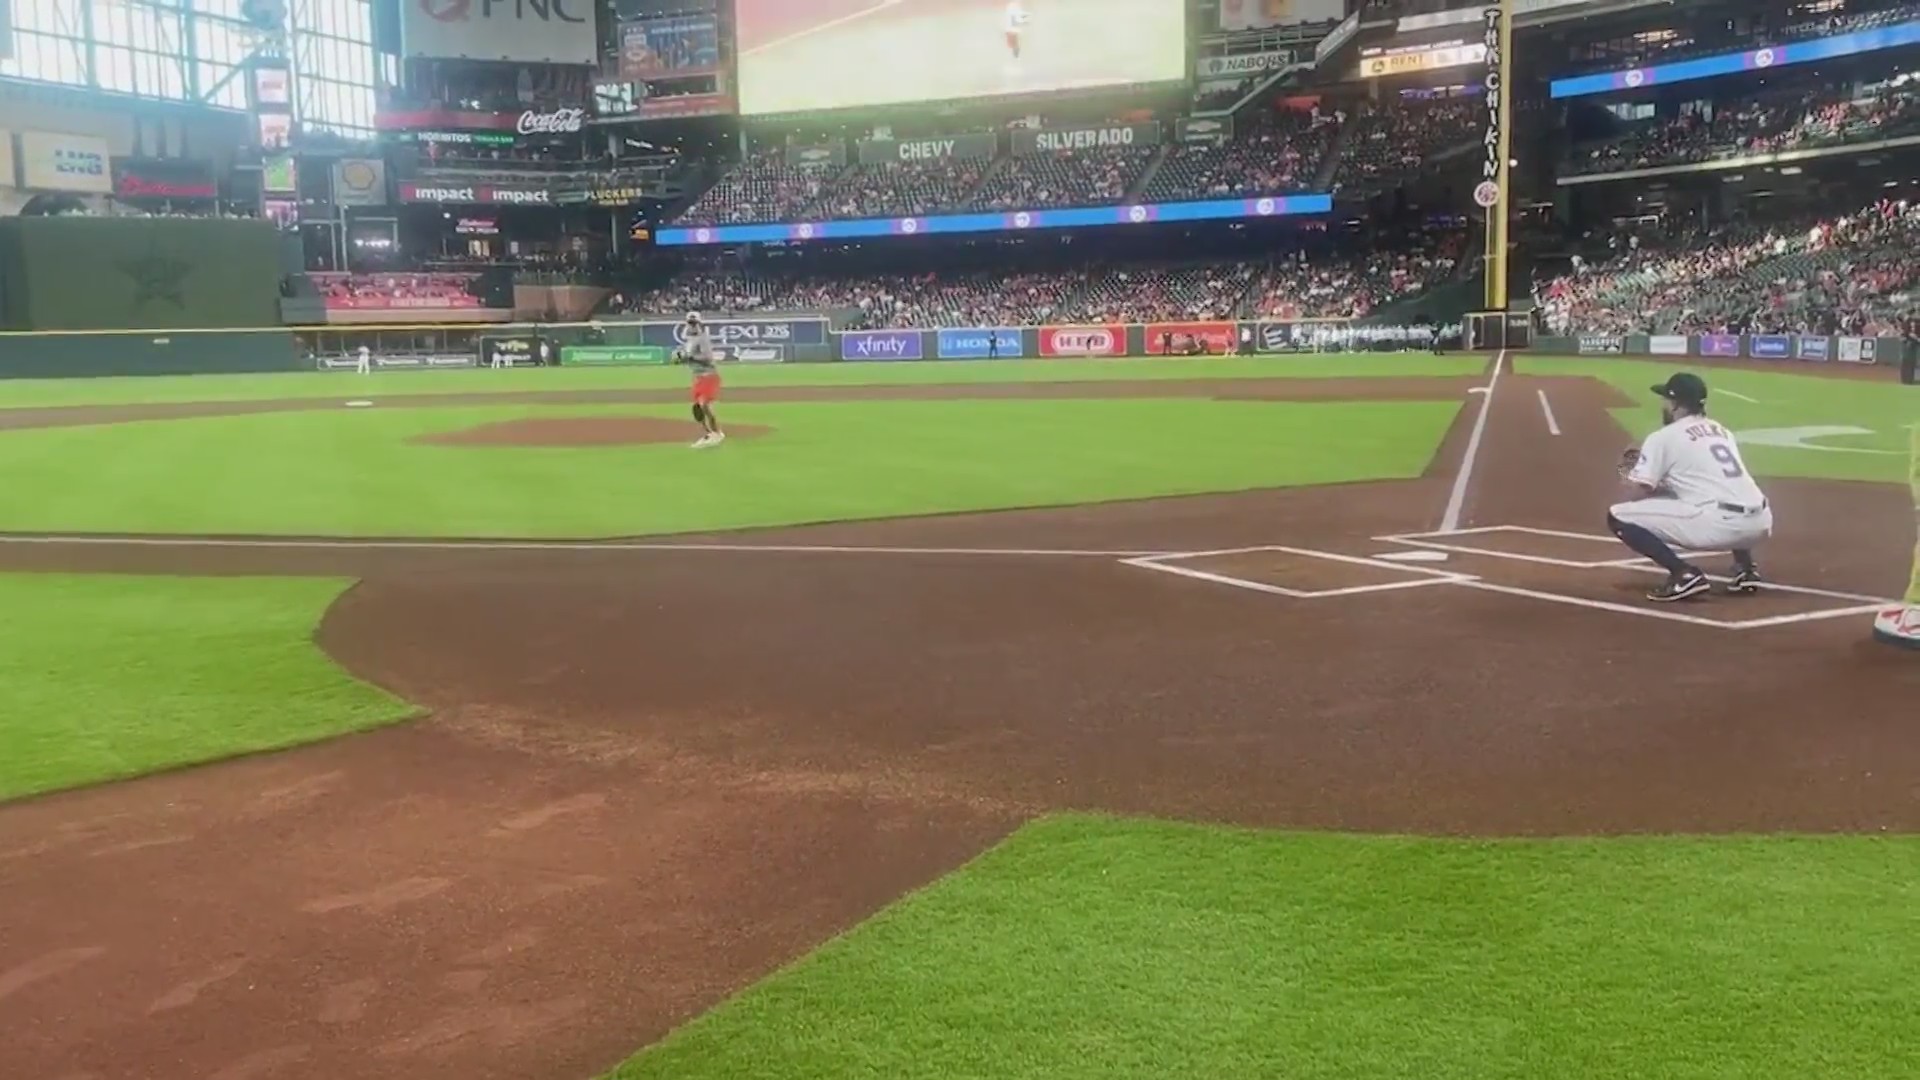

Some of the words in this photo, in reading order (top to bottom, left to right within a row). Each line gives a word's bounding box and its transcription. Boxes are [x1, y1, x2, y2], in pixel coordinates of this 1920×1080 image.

[1226, 53, 1287, 70] NABORS
[1035, 126, 1134, 151] SILVERADO
[899, 140, 955, 160] CHEVY
[415, 187, 474, 202] impact
[492, 189, 549, 204] impact
[856, 335, 907, 356] xfinity
[1709, 444, 1743, 478] 9
